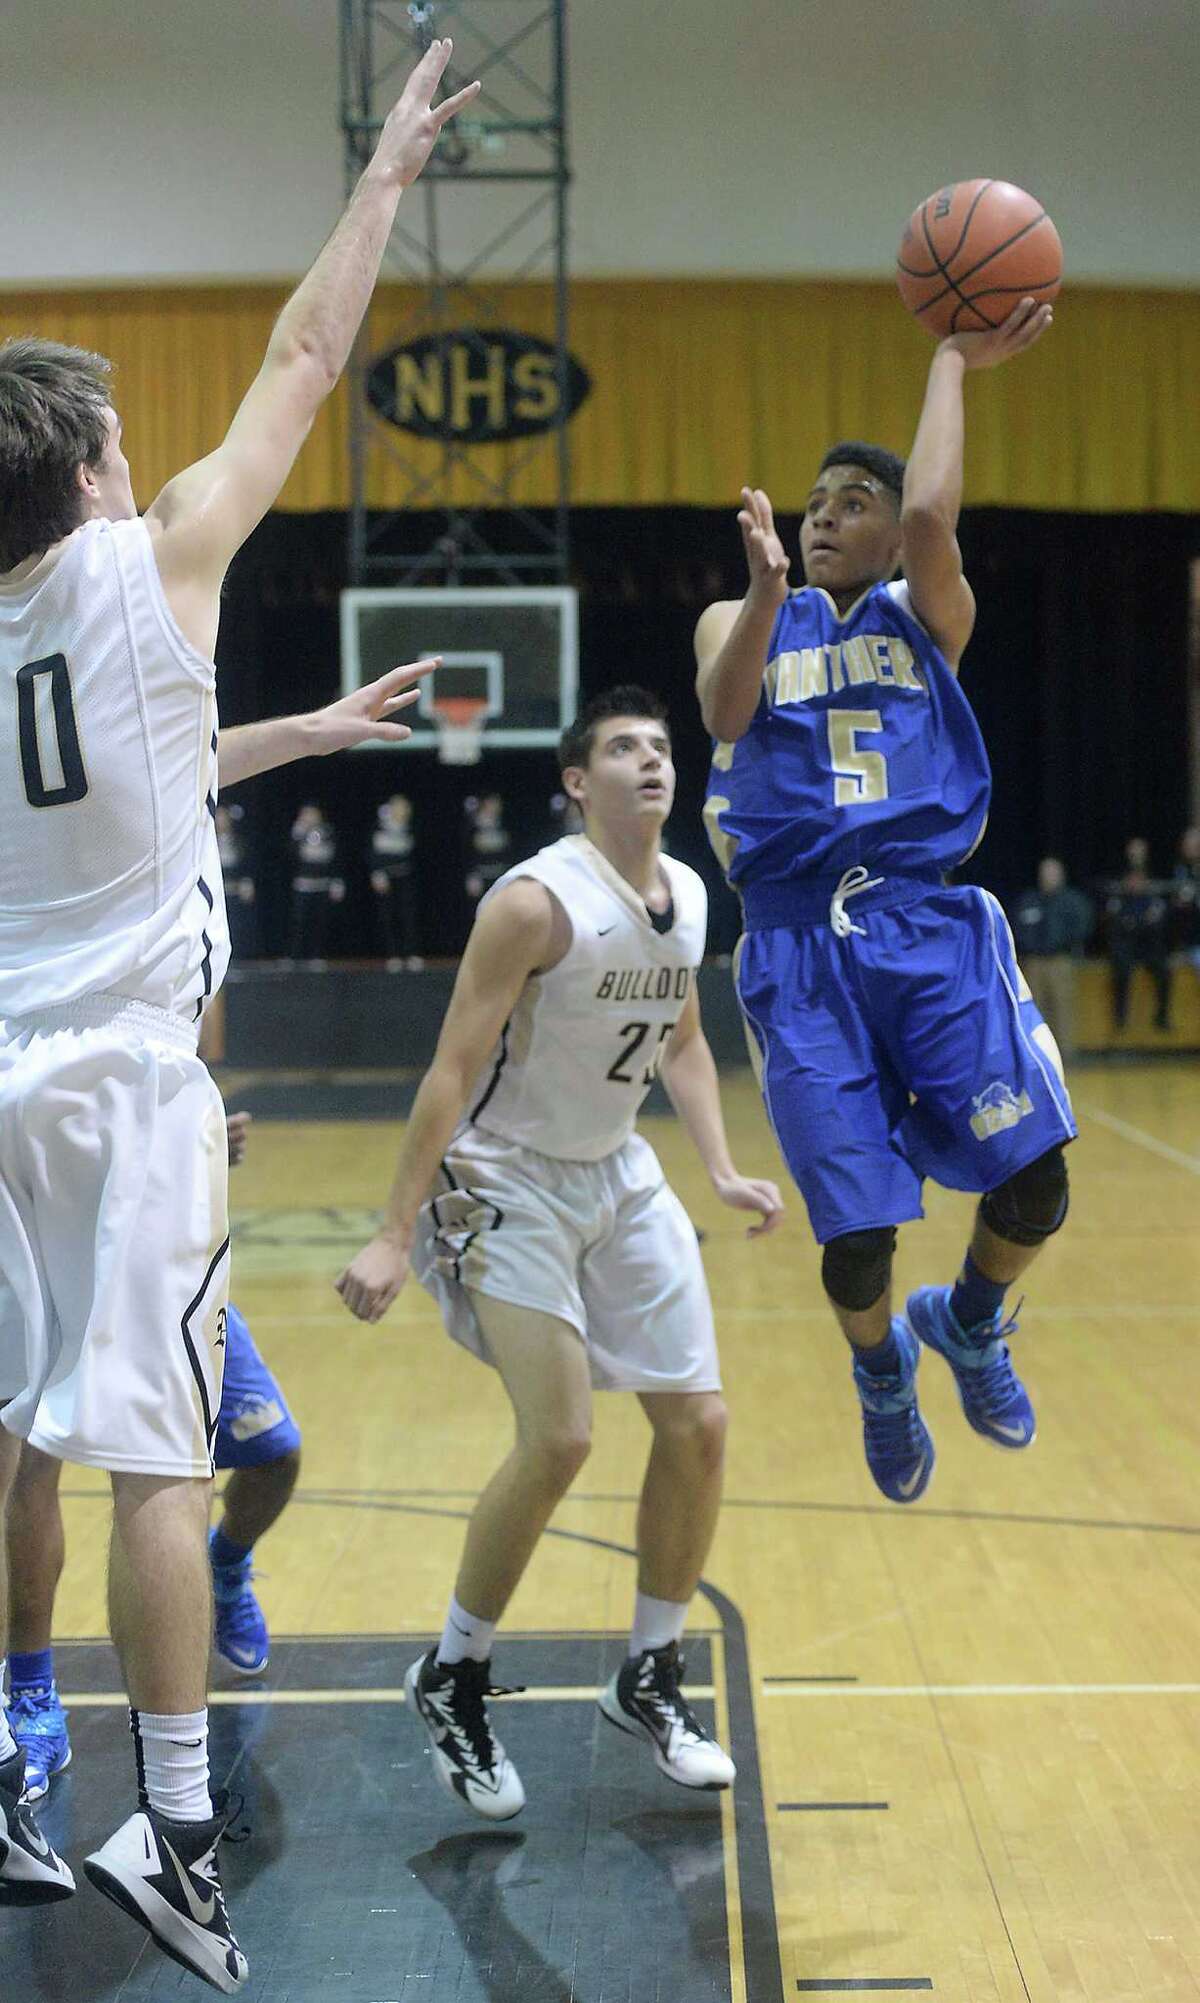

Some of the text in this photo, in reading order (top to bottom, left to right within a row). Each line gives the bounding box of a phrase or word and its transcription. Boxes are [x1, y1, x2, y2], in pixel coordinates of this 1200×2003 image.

[394, 345, 562, 430] NHS
[763, 634, 929, 709] ANTHER
[16, 652, 89, 809] 0
[827, 708, 889, 807] 5
[596, 966, 698, 1001] BULLDO
